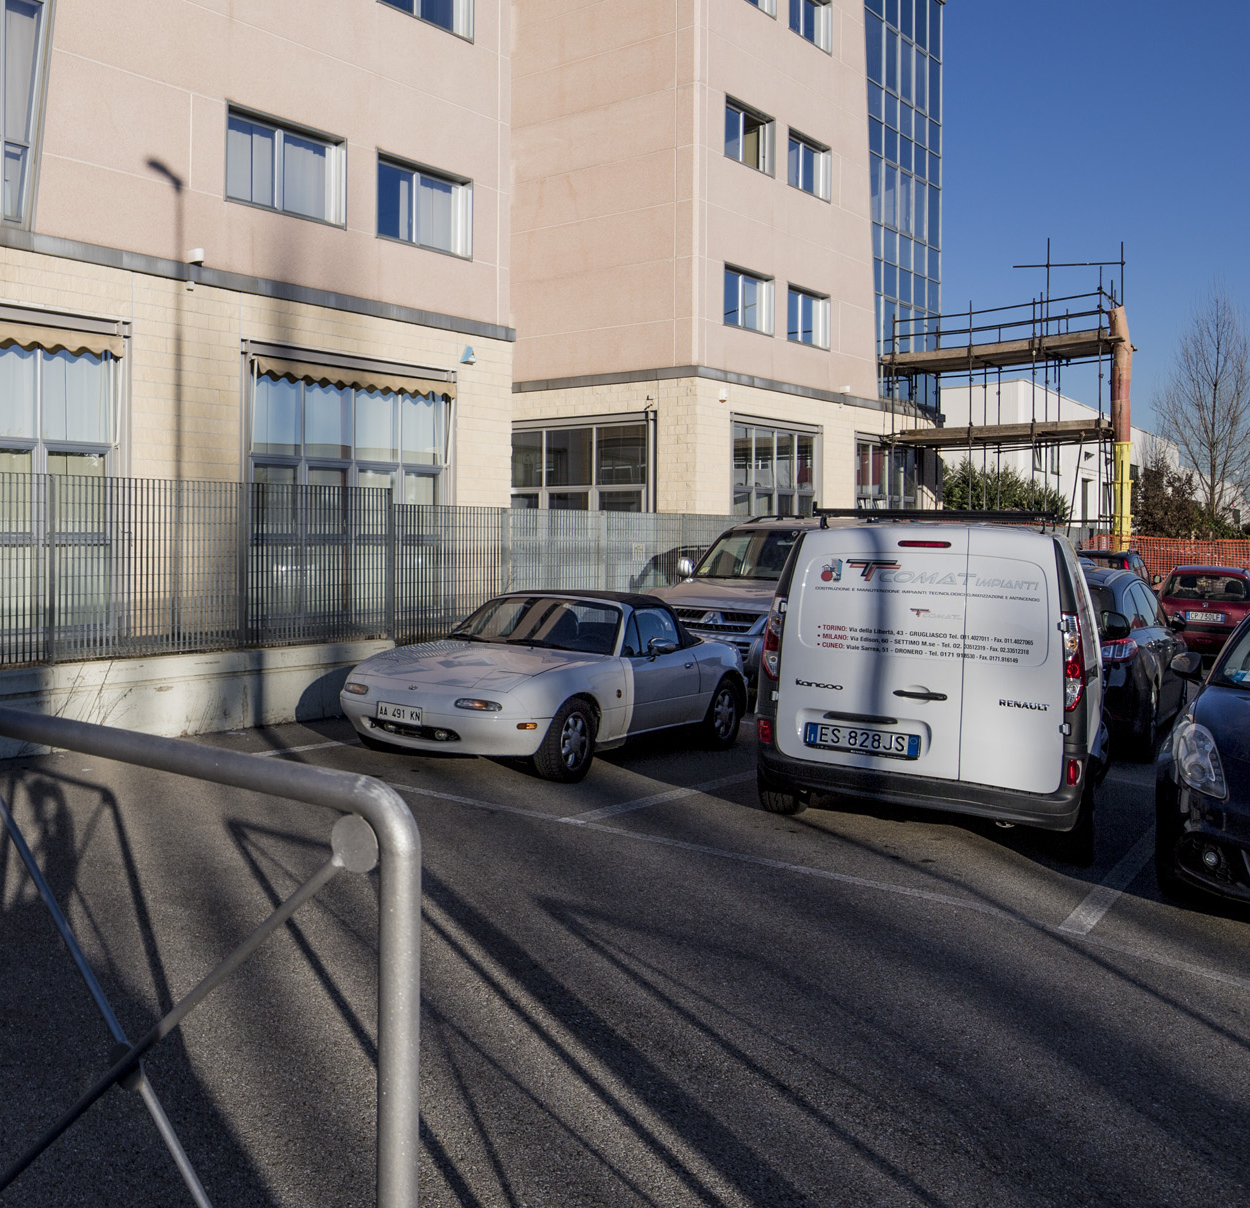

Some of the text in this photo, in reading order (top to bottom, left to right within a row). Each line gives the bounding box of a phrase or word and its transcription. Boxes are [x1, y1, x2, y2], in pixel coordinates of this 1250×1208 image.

[976, 578, 1039, 591] IMPIANTI
[823, 624, 848, 632] TORINO:
[909, 631, 948, 639] GRUGLIASCO
[822, 633, 849, 641] MILANO:
[894, 638, 920, 646] SETTIMO
[999, 698, 1050, 711] RENAULT
[380, 706, 420, 721] AA 491 KN
[819, 726, 906, 752] ES 828JS
